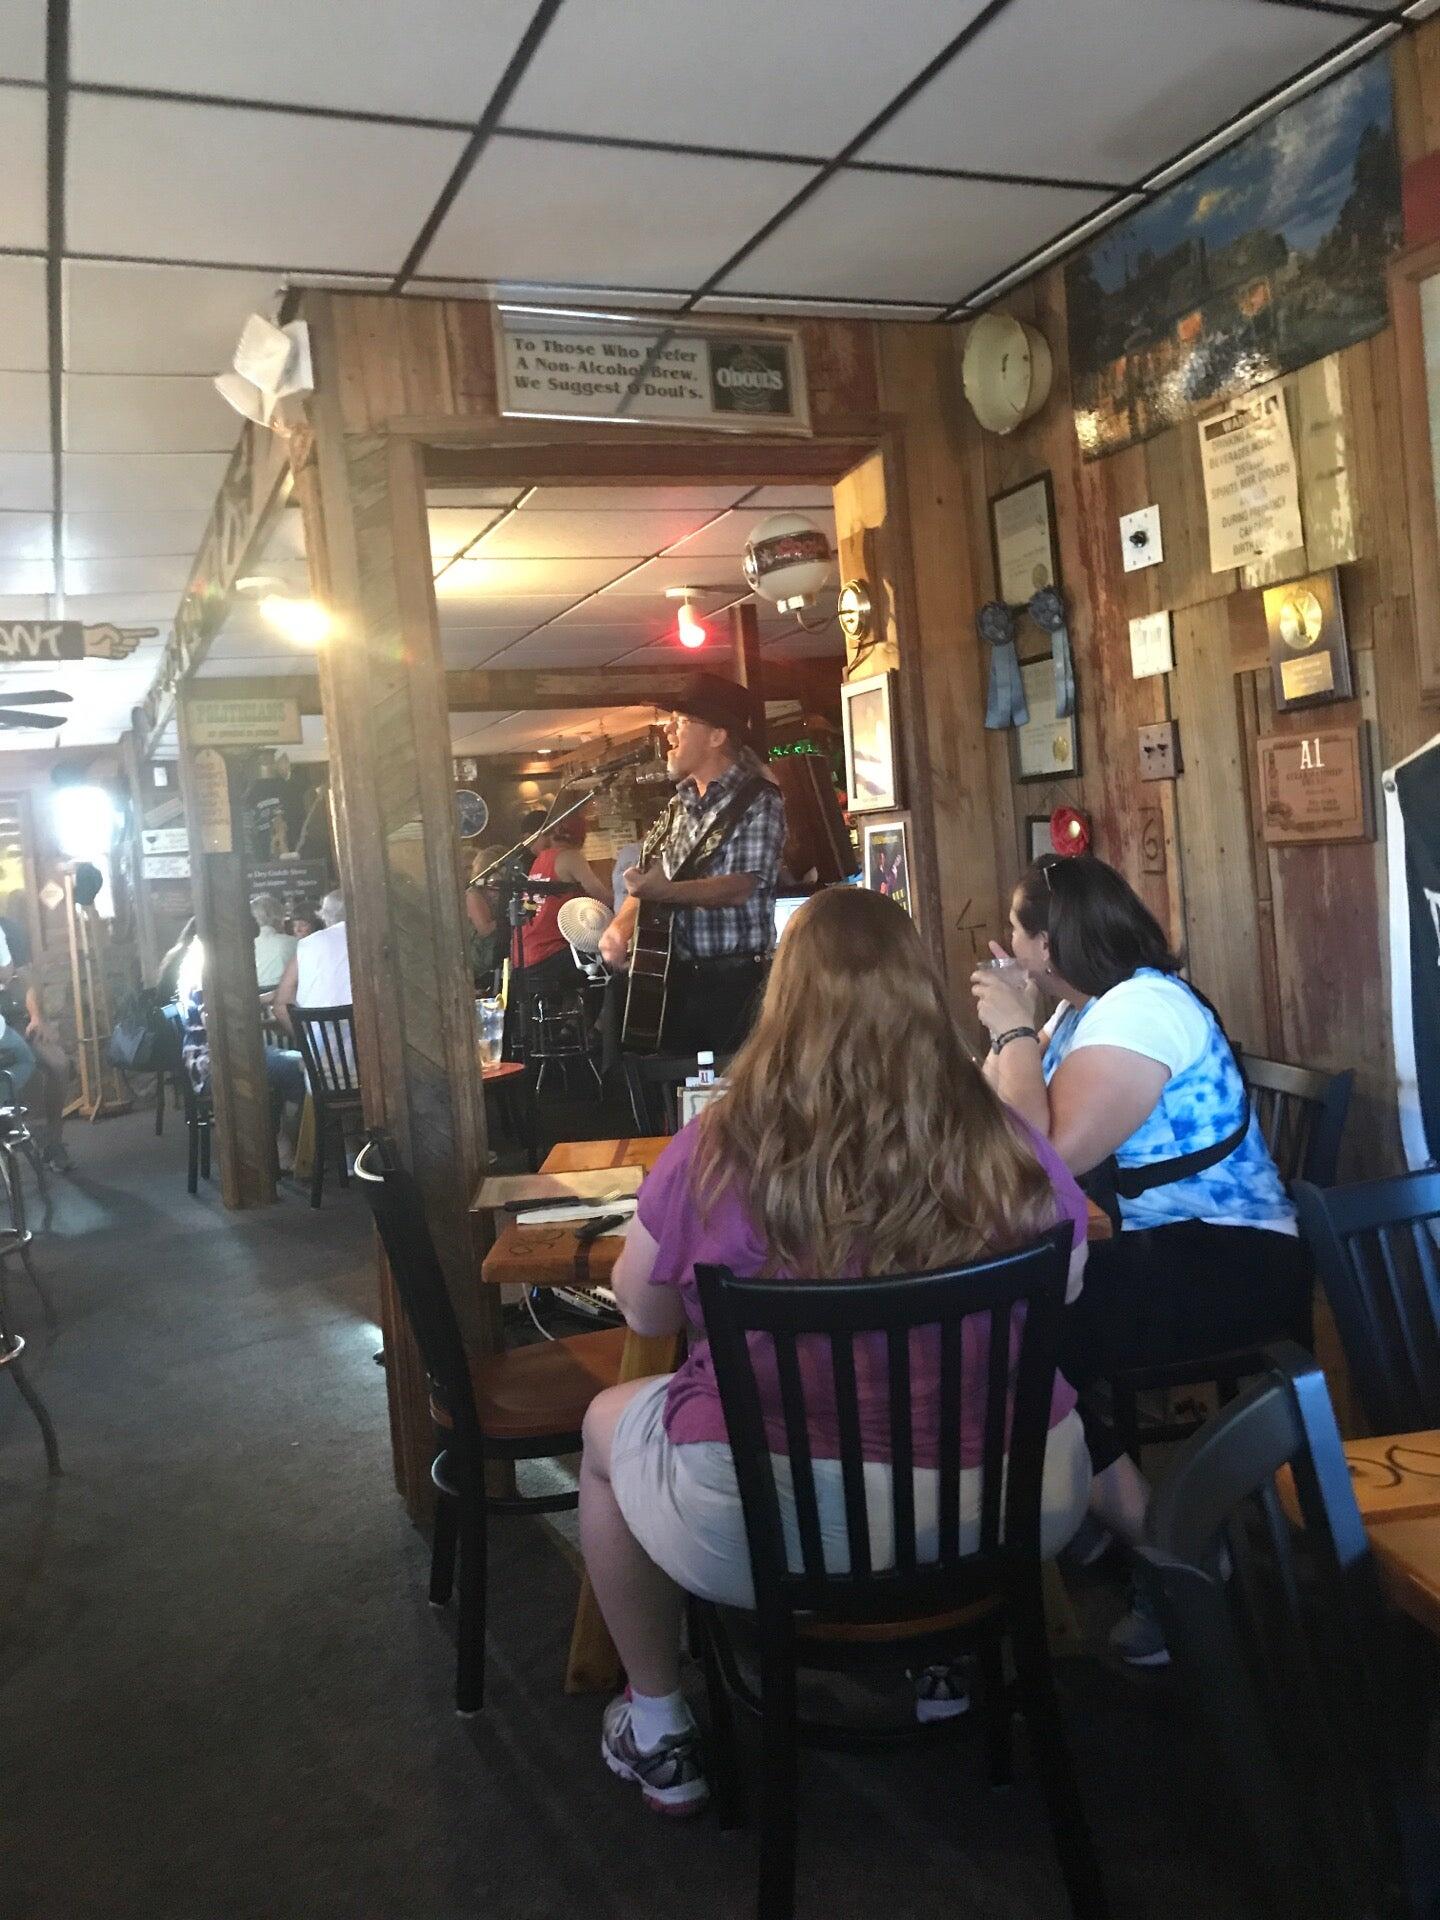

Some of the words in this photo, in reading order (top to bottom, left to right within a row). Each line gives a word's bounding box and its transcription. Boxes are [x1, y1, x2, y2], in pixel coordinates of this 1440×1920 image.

[513, 338, 535, 351] To
[543, 339, 596, 356] Those
[601, 343, 639, 358] Who
[646, 347, 697, 363] Prefer
[517, 357, 528, 370] A
[536, 357, 648, 378] Non-Alcohol
[651, 365, 698, 382] Brew.
[514, 376, 541, 391] We
[547, 377, 620, 396] Suggest
[628, 381, 703, 399] O'Doul's.
